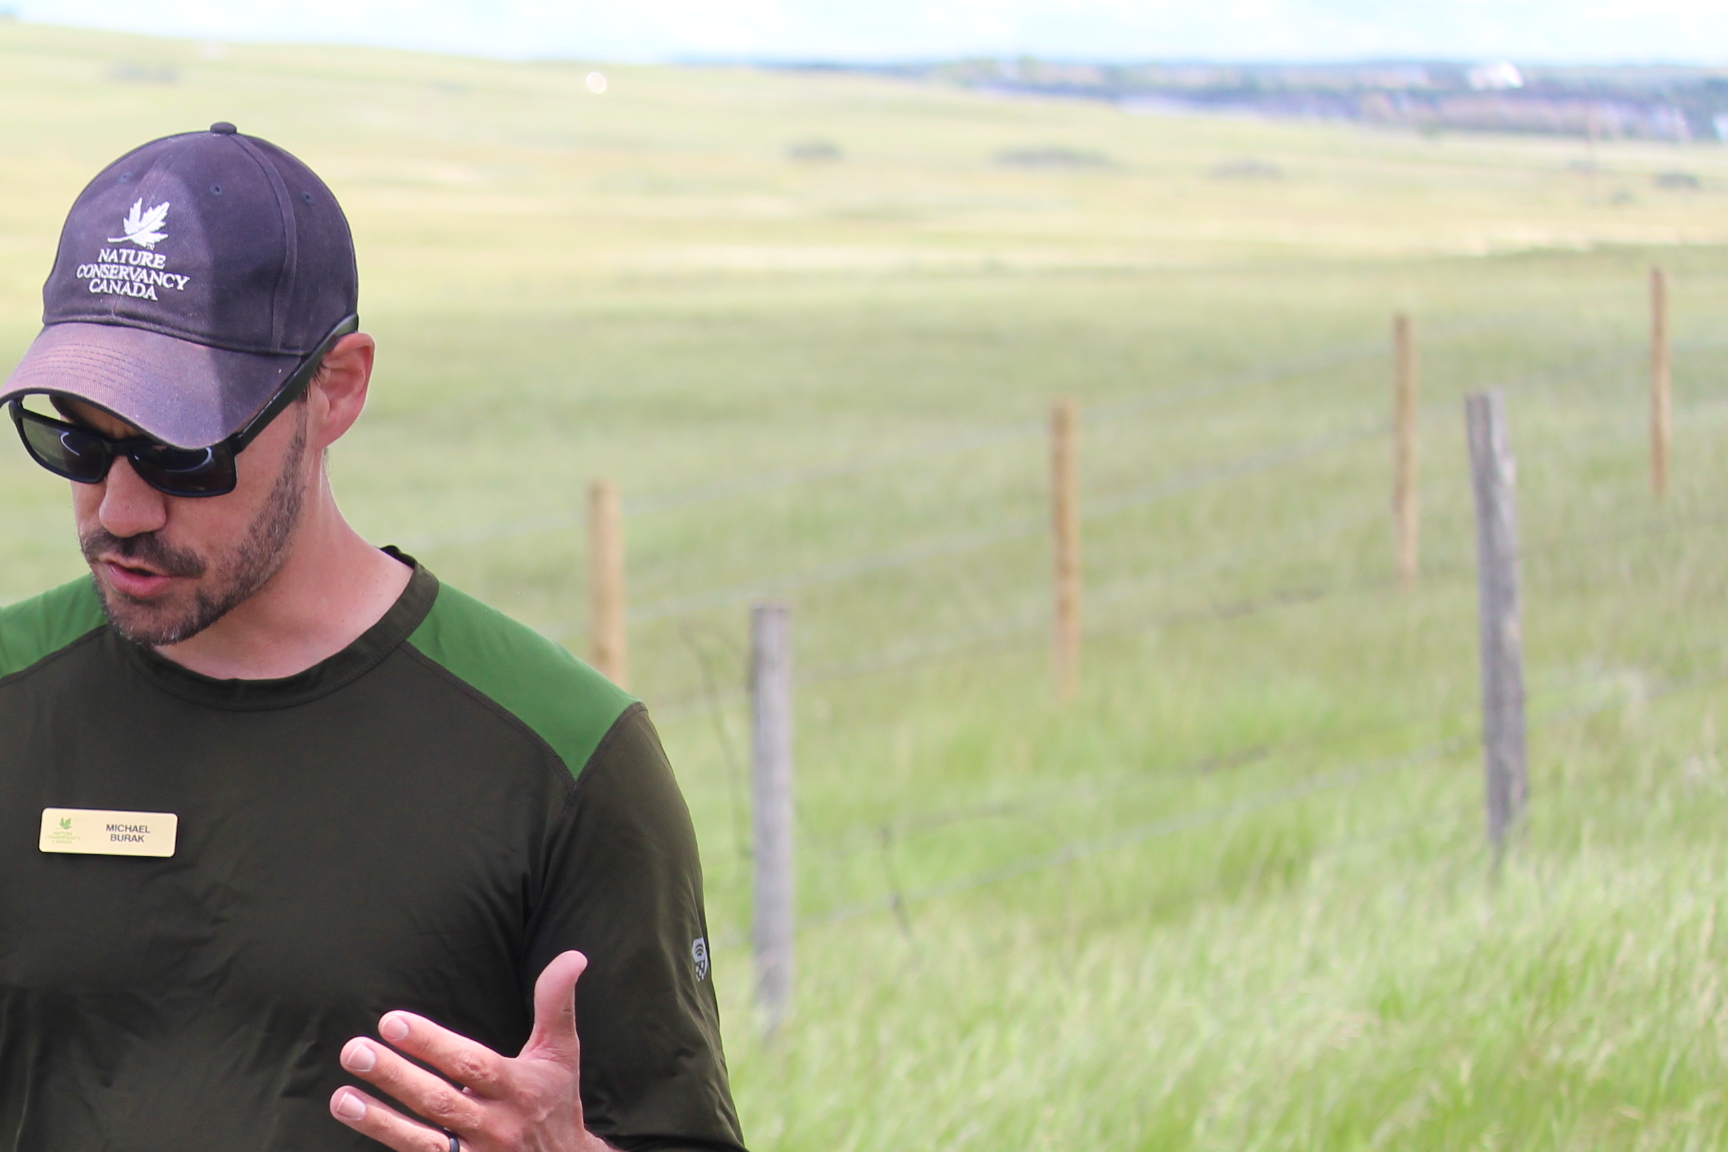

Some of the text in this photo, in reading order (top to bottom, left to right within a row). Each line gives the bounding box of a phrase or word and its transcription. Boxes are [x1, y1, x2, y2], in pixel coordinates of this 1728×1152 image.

[98, 249, 166, 269] NATURE
[76, 264, 190, 290] CONSERVANCY
[89, 279, 158, 300] CANADA
[105, 823, 151, 834] MICHAEL
[110, 833, 145, 843] BURAK
